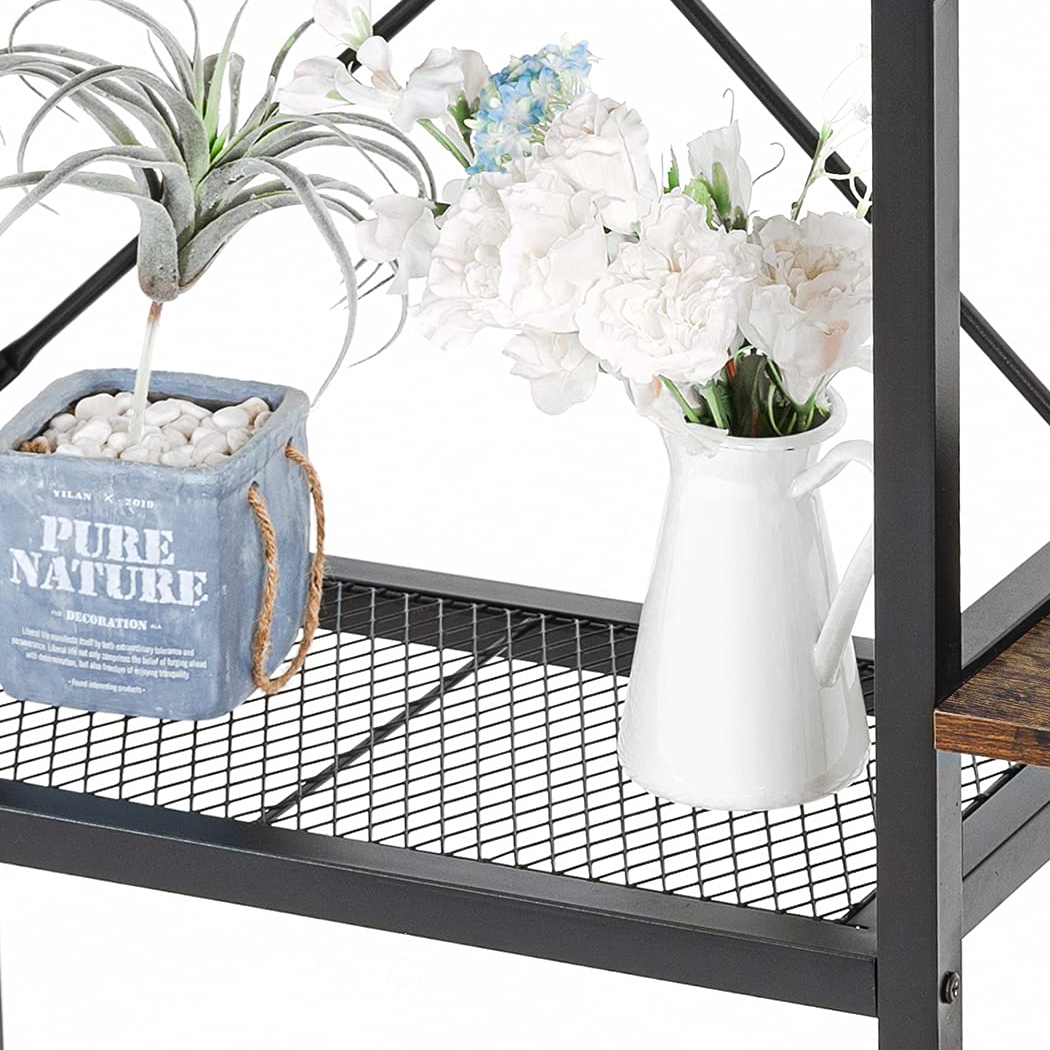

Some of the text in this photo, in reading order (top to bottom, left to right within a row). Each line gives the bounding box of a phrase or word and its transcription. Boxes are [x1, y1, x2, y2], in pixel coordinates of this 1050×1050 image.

[53, 489, 92, 501] YILAN
[40, 515, 175, 565] PURE
[9, 548, 209, 607] NATURE
[65, 609, 148, 631] DECORATION
